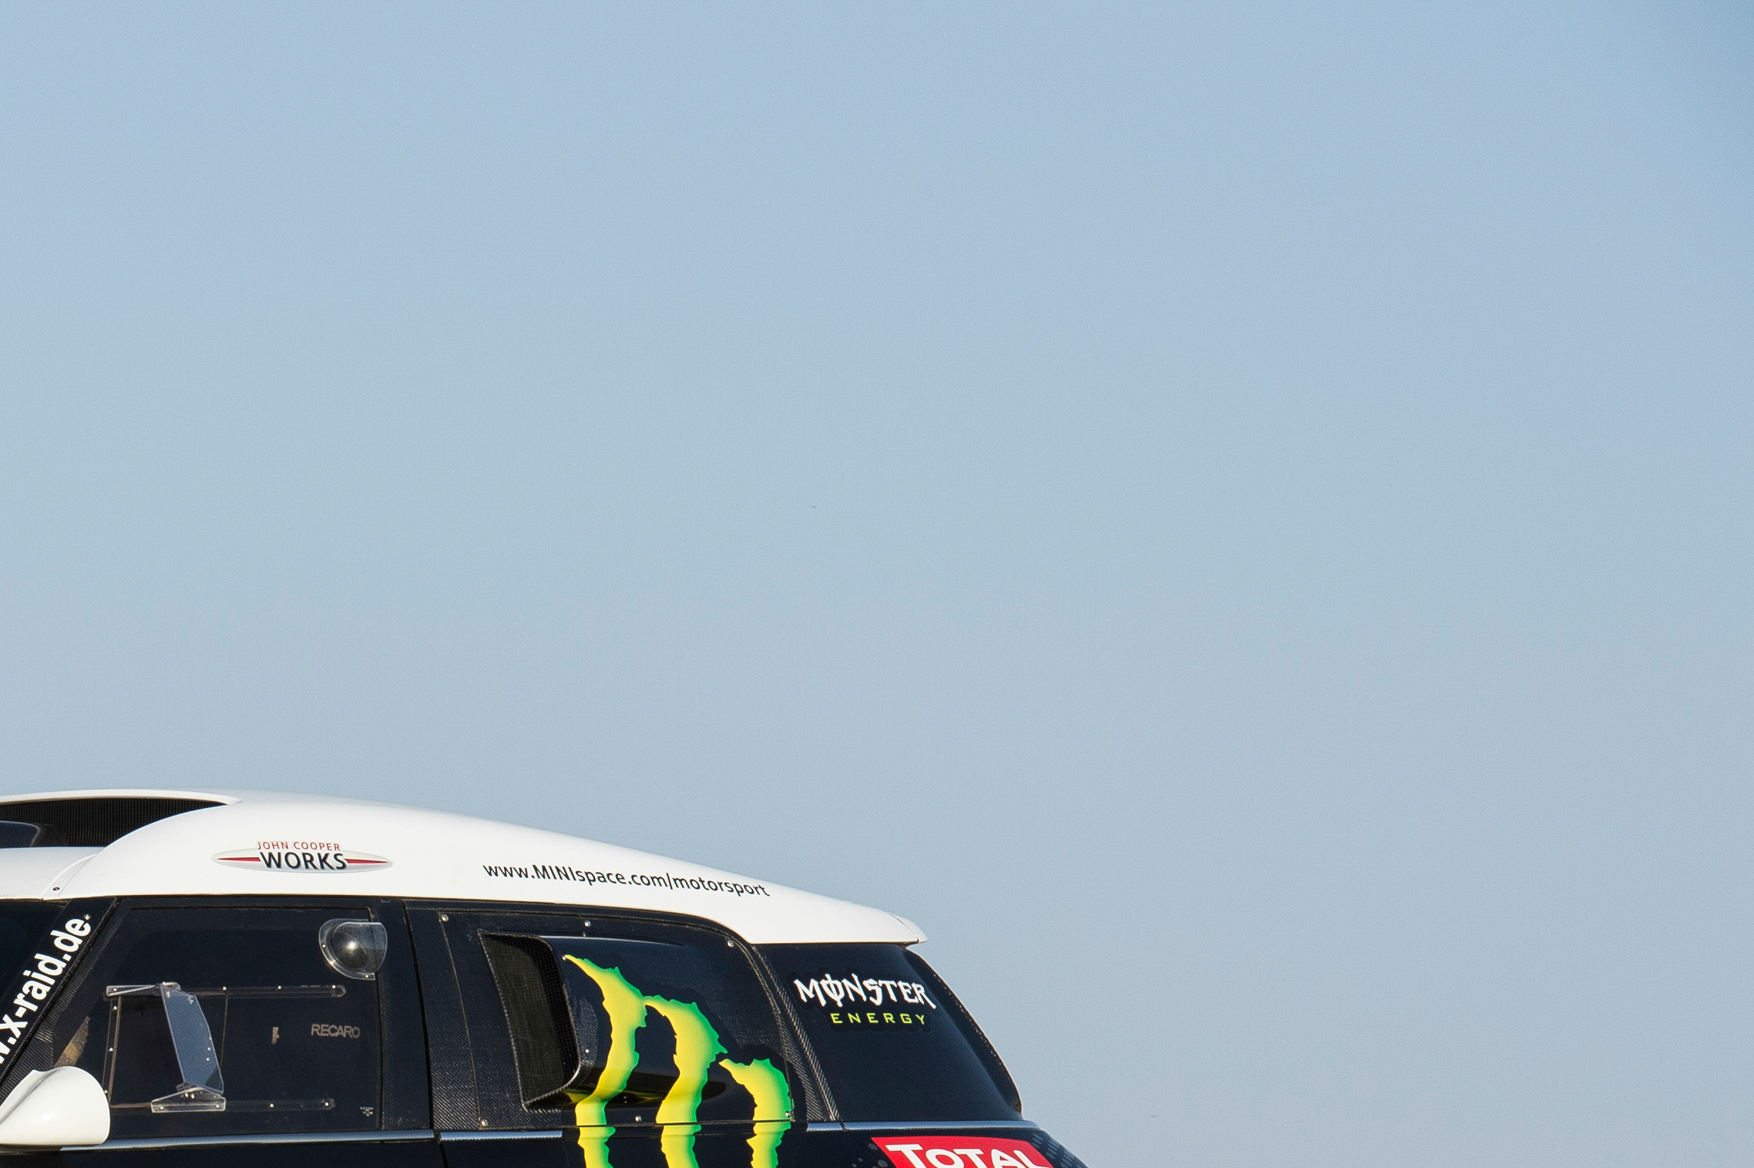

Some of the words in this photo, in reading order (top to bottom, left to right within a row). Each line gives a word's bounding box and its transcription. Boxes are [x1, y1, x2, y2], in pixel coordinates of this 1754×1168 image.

[257, 841, 289, 850] JOHN
[293, 841, 341, 851] COOPER
[259, 851, 347, 870] WORKS
[482, 864, 771, 897] www.MINIspace.com/motorsport
[793, 973, 937, 1010] MONSTER
[830, 1012, 927, 1026] ENERGY
[310, 1023, 361, 1039] RECARO
